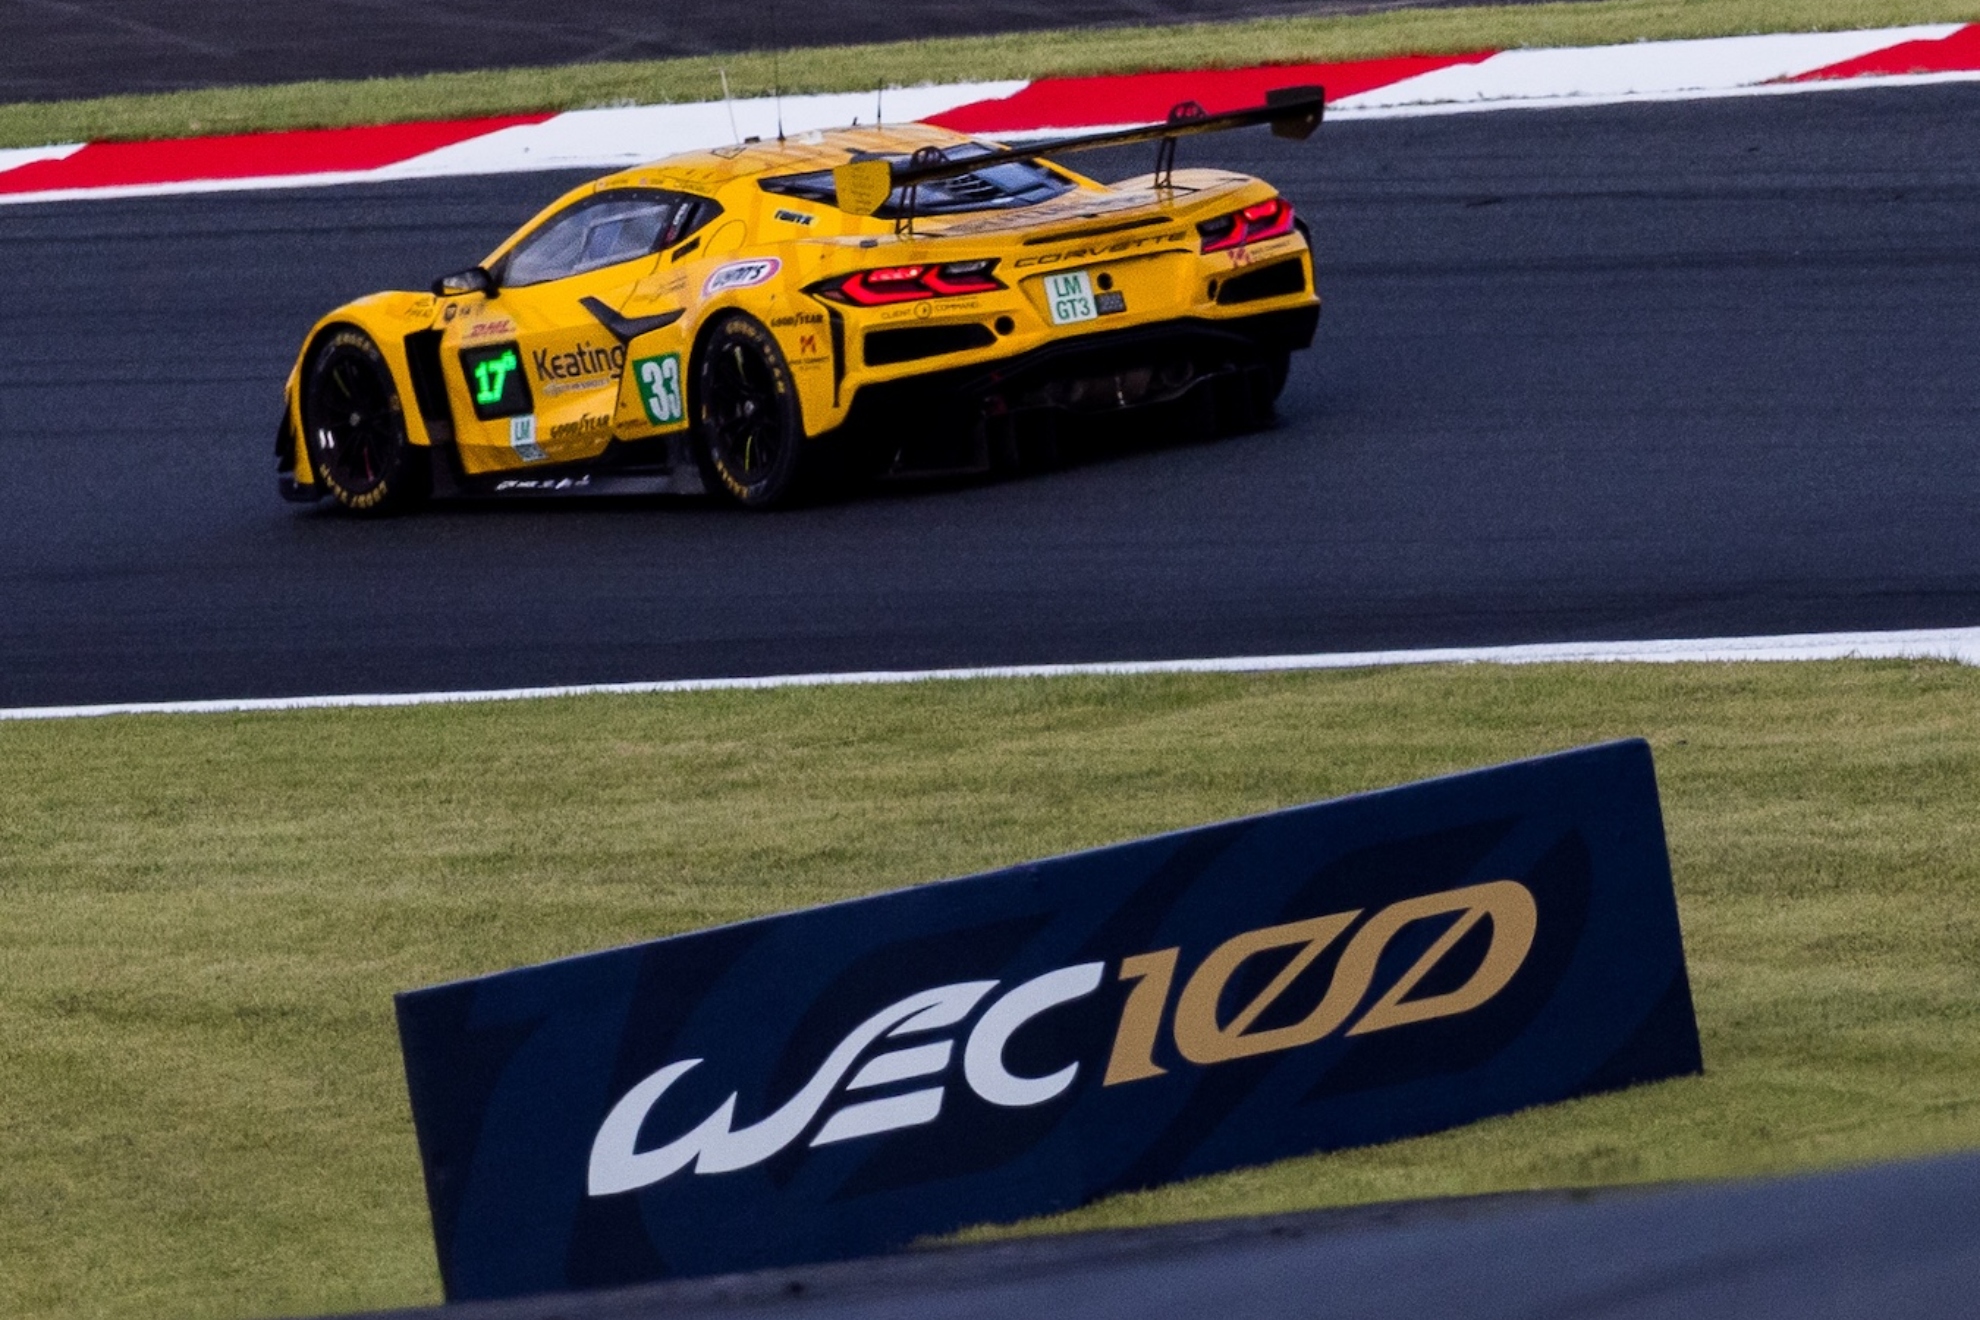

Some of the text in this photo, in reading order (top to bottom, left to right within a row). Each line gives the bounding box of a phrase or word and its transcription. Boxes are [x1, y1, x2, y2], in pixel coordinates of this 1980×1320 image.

[1014, 231, 1187, 268] CORVETTE
[1053, 275, 1082, 298] LM
[1056, 297, 1091, 320] GT3
[533, 341, 627, 382] Keating
[640, 357, 682, 421] 33
